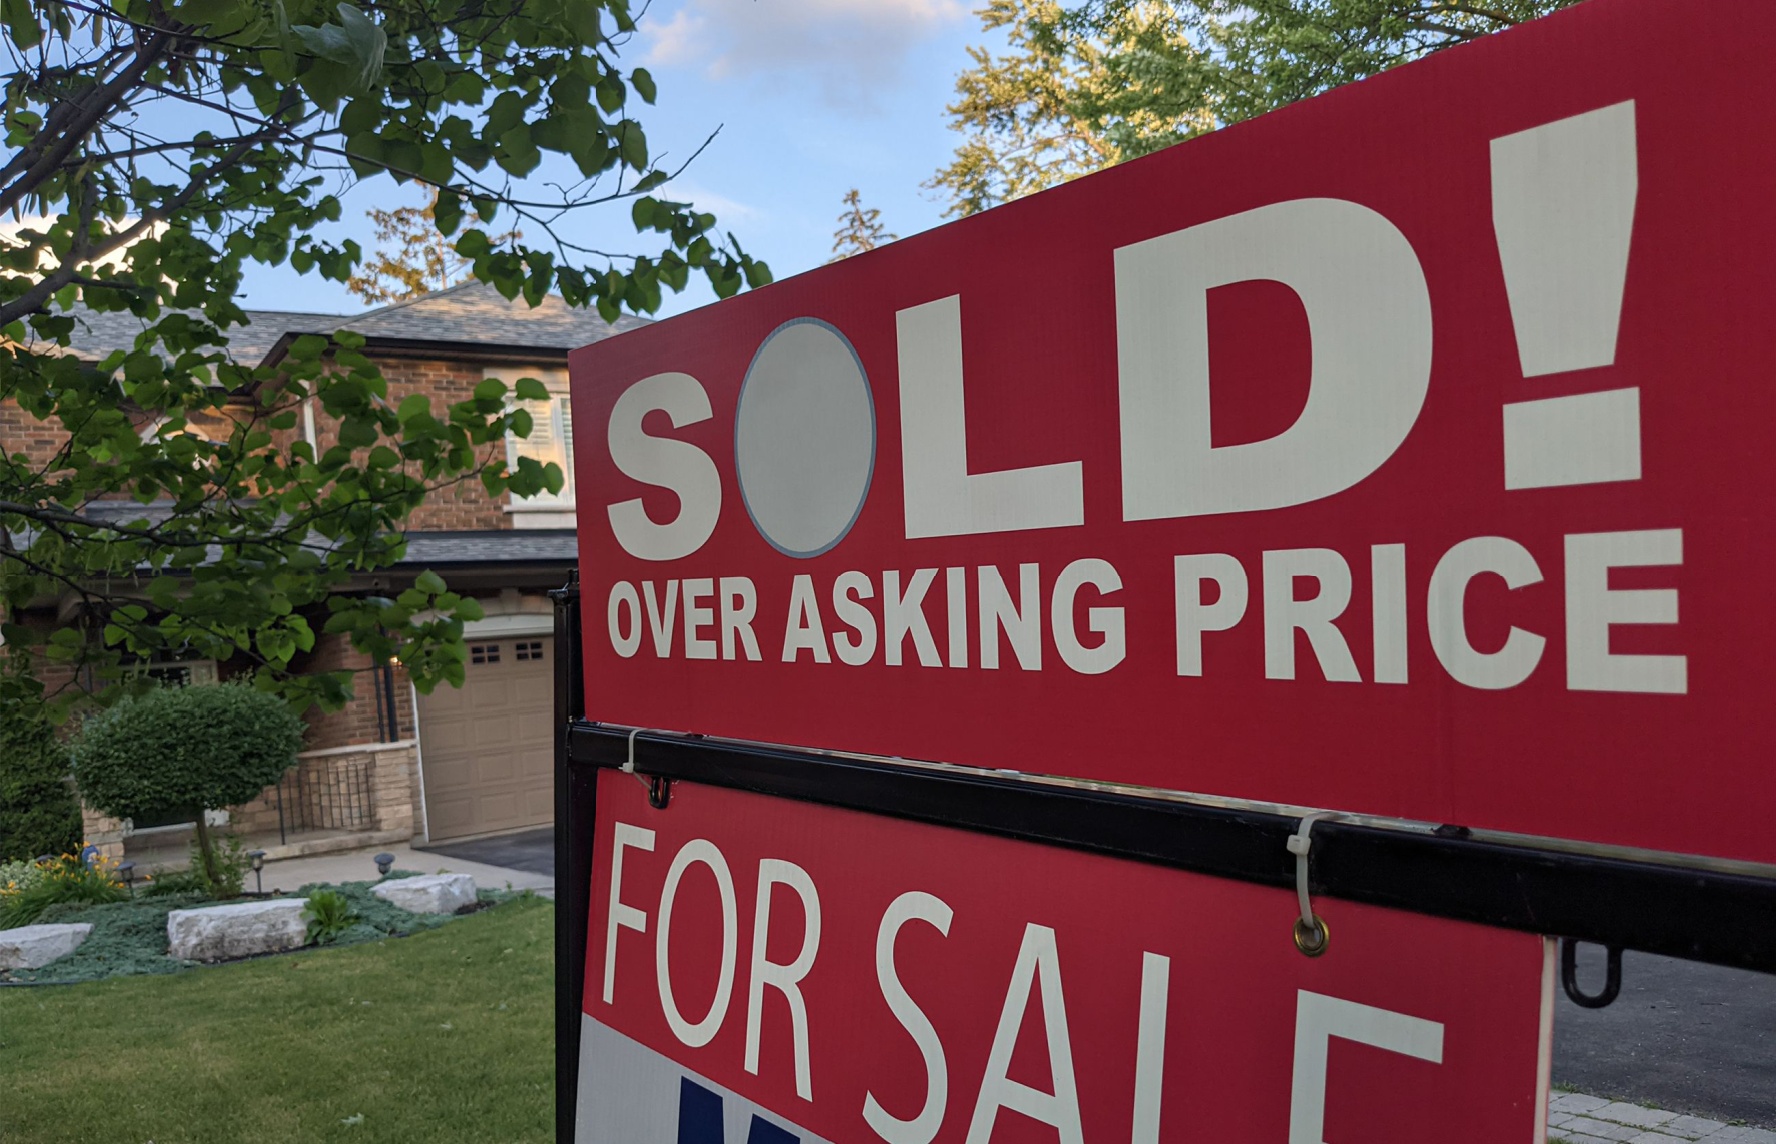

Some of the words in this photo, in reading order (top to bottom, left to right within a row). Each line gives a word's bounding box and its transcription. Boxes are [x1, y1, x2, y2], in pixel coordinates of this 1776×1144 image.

[607, 576, 762, 662] OVER
[781, 558, 1127, 674] ASKING
[1174, 528, 1688, 694] PRICE
[602, 821, 821, 1102] FOR
